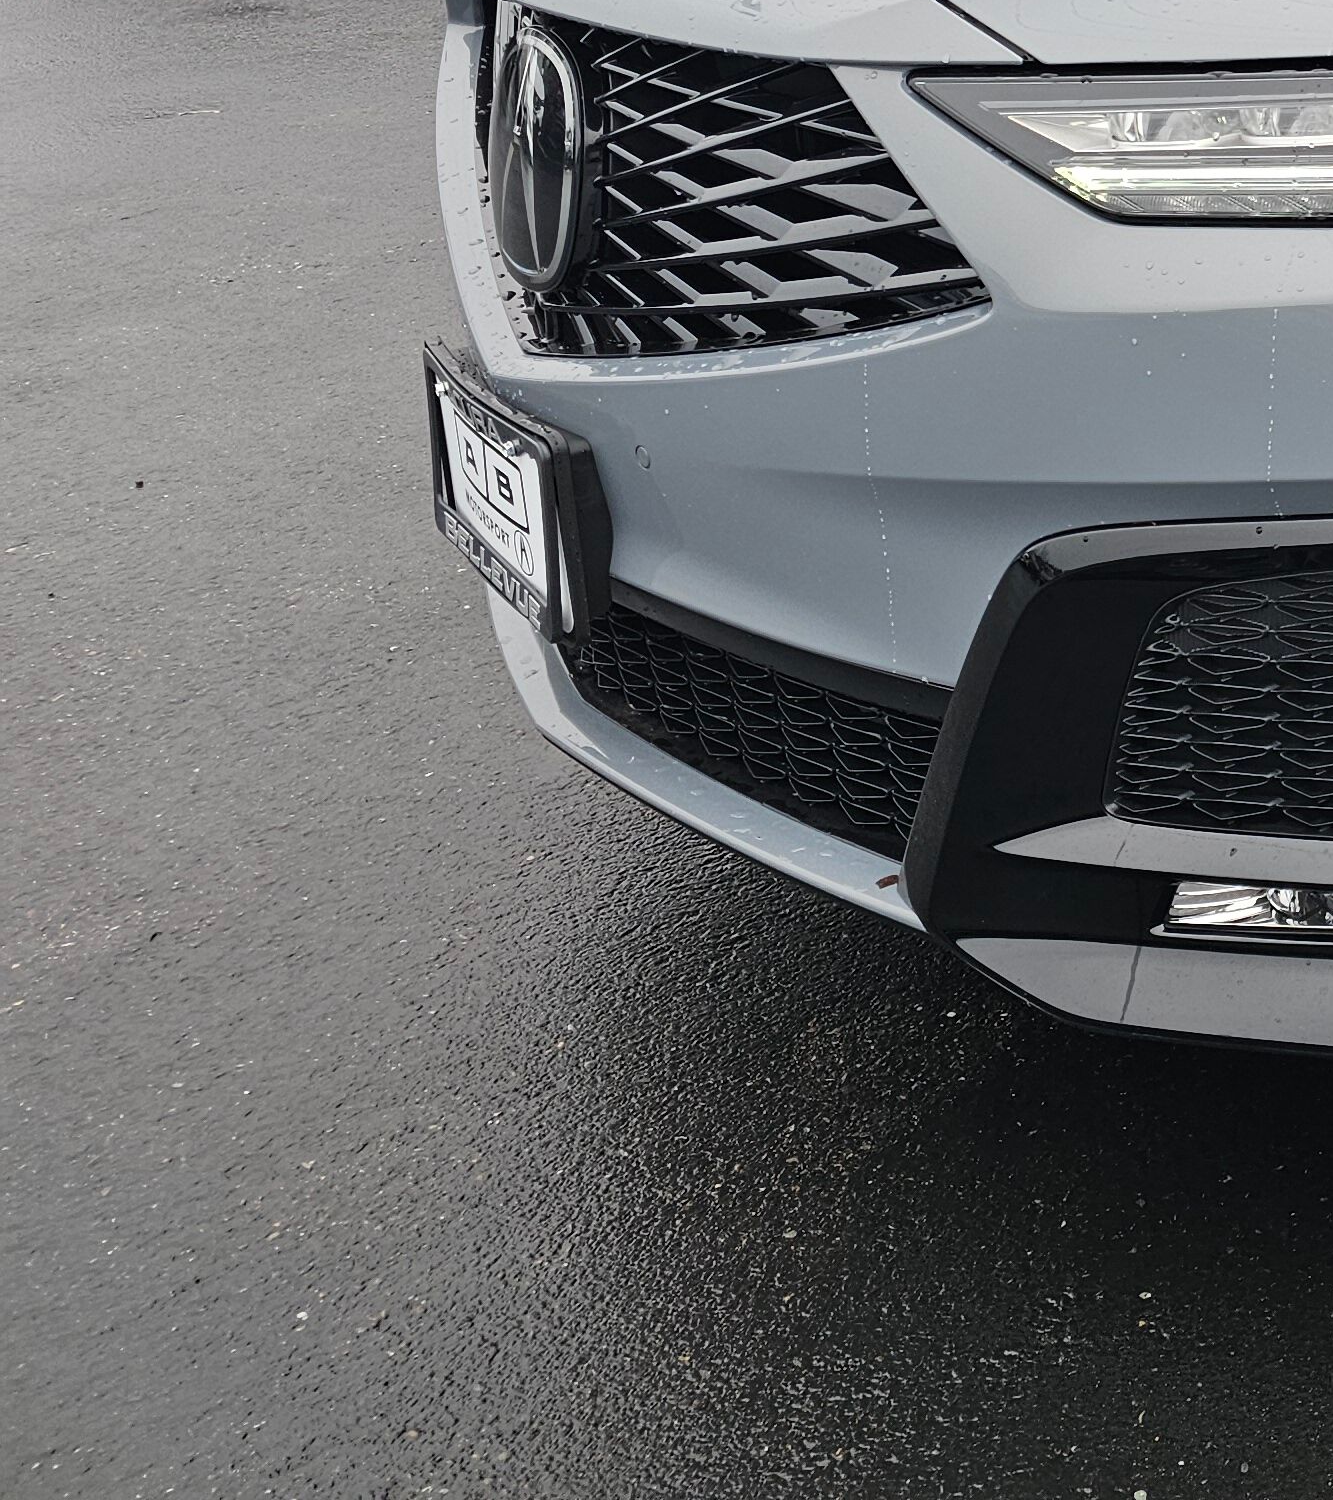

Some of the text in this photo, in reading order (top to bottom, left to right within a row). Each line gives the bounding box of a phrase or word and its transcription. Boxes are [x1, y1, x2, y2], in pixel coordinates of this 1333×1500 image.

[450, 389, 507, 450] CURA
[465, 488, 510, 548] MOTORSPORT
[444, 511, 541, 631] BELLEVUE
